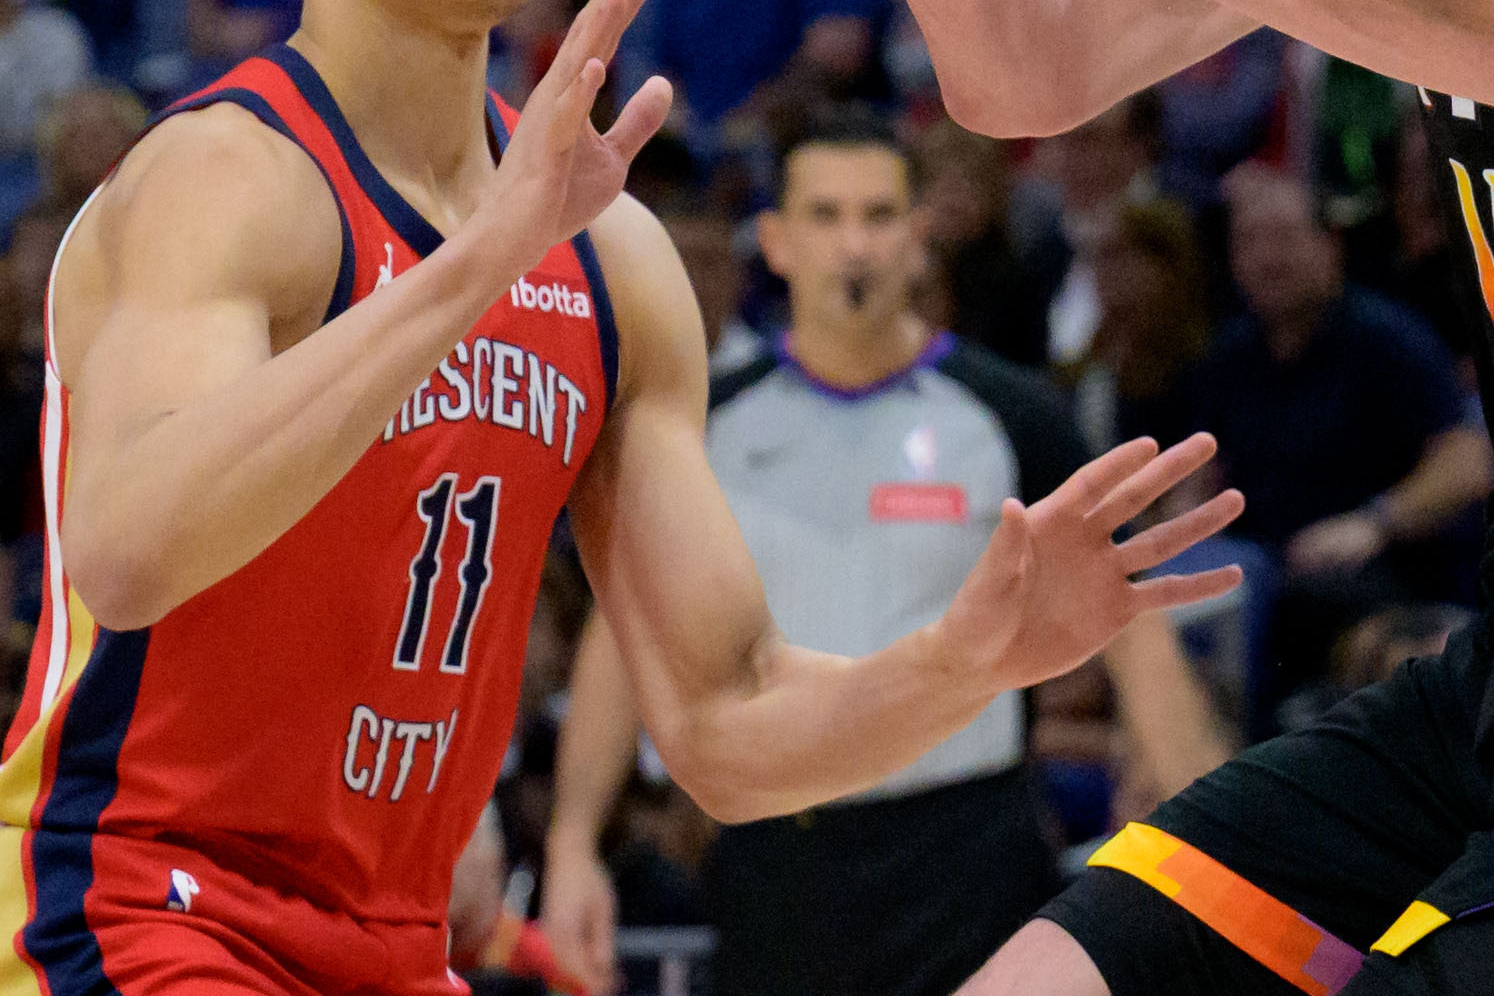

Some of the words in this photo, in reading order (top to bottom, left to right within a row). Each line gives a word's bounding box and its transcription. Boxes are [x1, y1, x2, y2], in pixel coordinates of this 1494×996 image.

[382, 336, 588, 468] ESCENT
[392, 472, 501, 674] 11
[342, 704, 459, 802] CITY
